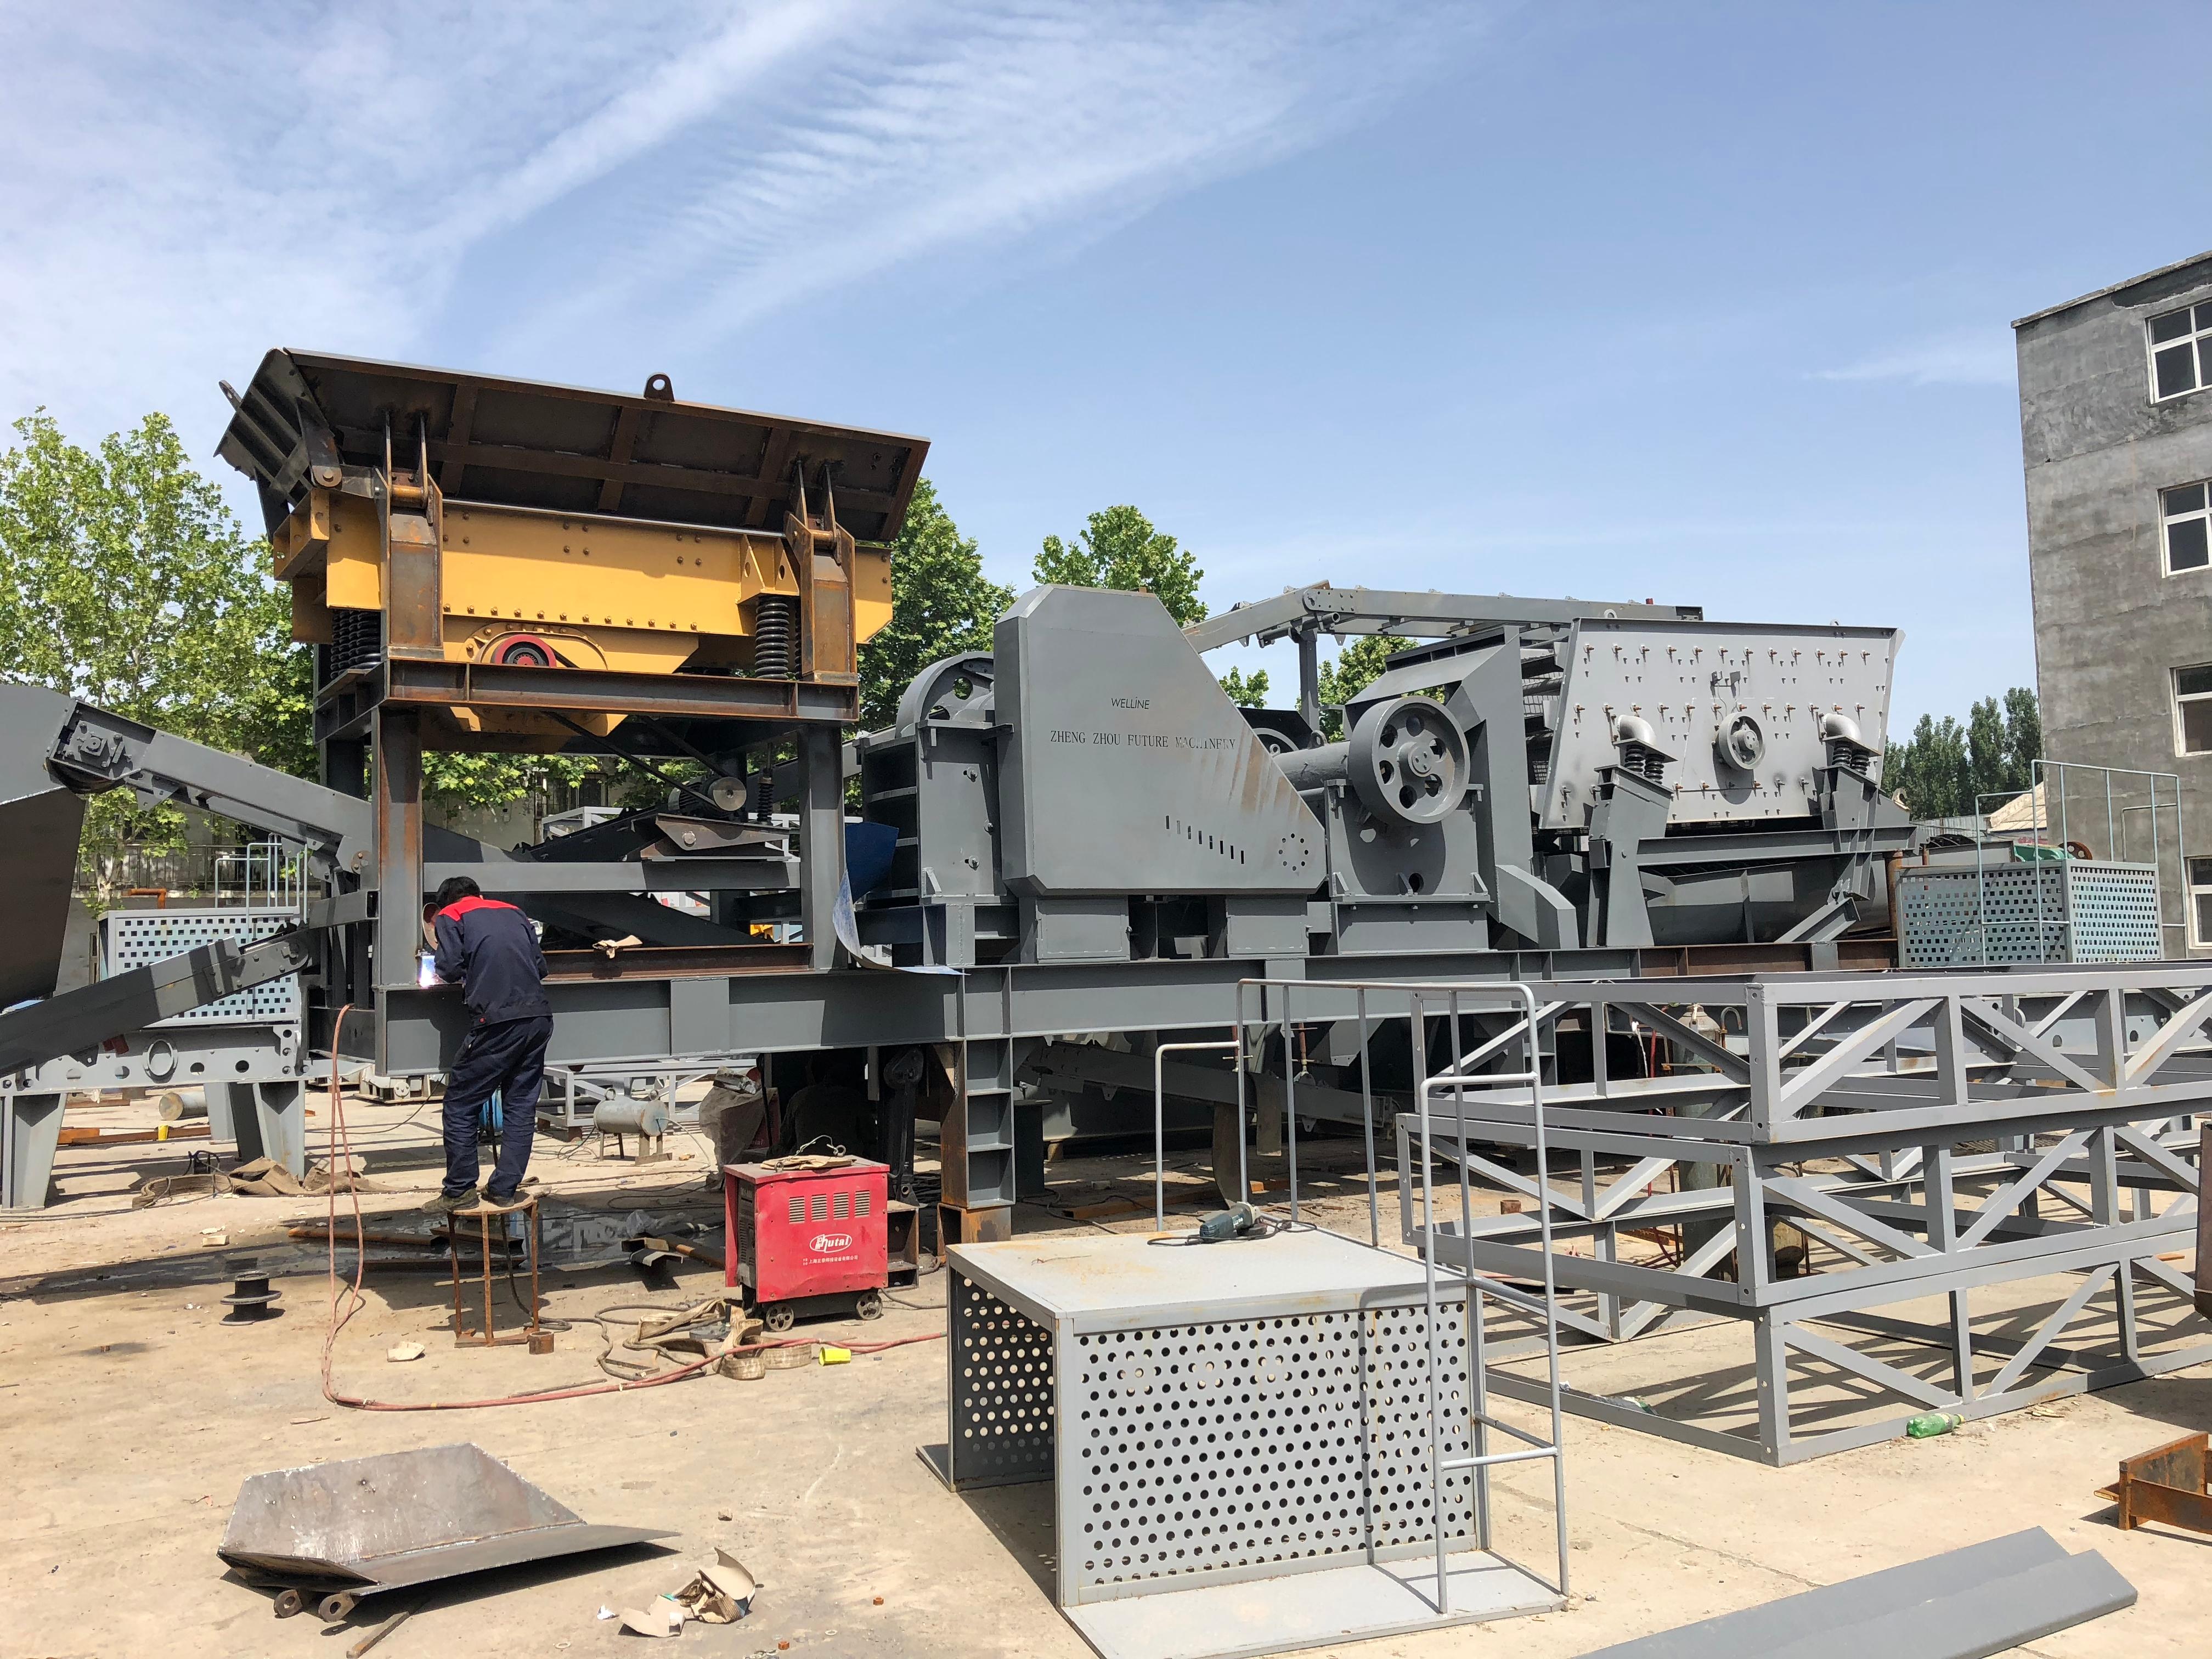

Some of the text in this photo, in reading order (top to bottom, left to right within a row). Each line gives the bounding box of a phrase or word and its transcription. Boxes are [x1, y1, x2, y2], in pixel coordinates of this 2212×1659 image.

[1050, 730, 1236, 749] ZHENG ZHOU FUTURE MACINERY
